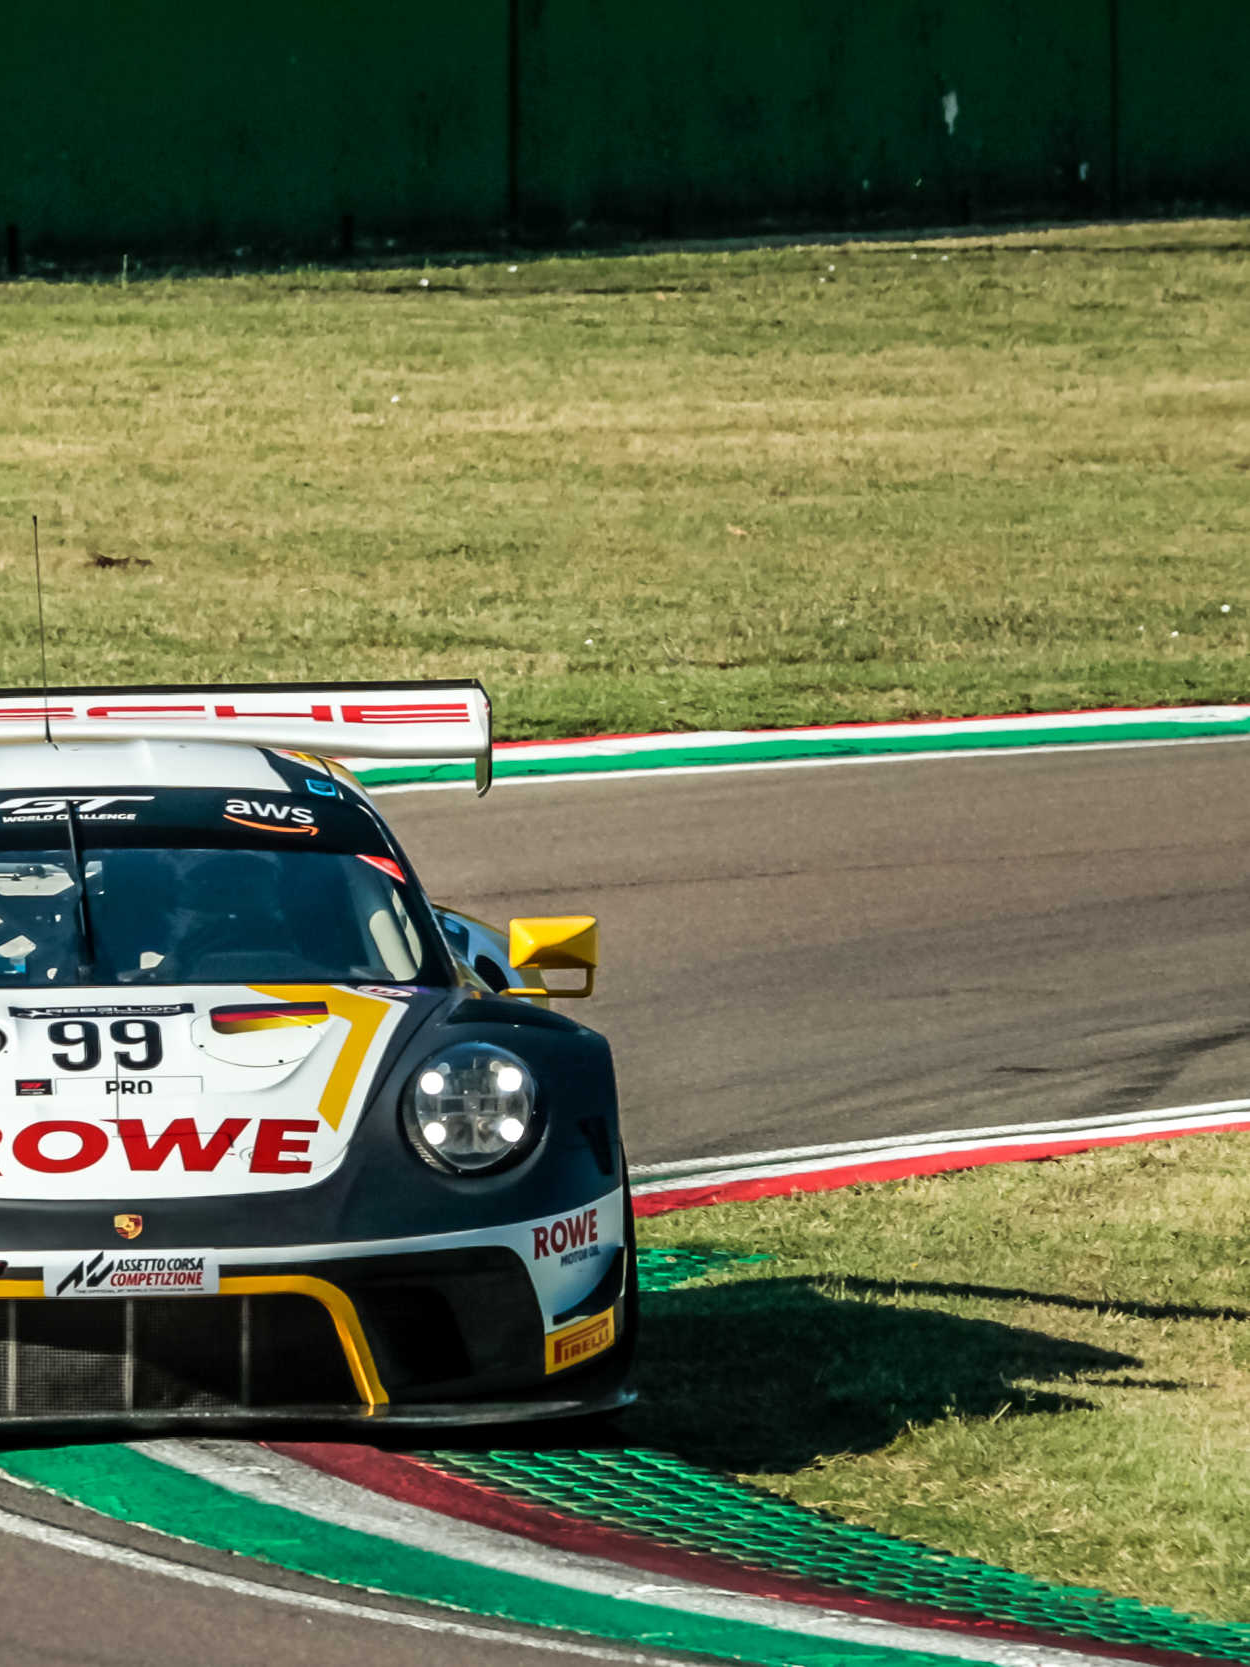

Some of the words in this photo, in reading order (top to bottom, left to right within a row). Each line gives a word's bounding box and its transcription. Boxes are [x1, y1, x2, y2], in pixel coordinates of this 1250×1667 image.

[2, 814, 53, 823] WORLD
[225, 799, 315, 824] aws
[47, 1020, 163, 1071] 99
[105, 1081, 153, 1095] PRO
[531, 1208, 598, 1260] ROWE
[116, 1258, 166, 1272] ASSETTO
[167, 1257, 205, 1271] CORSA
[110, 1272, 203, 1287] COMPETIZIONE
[554, 1318, 608, 1364] PIRELLI
